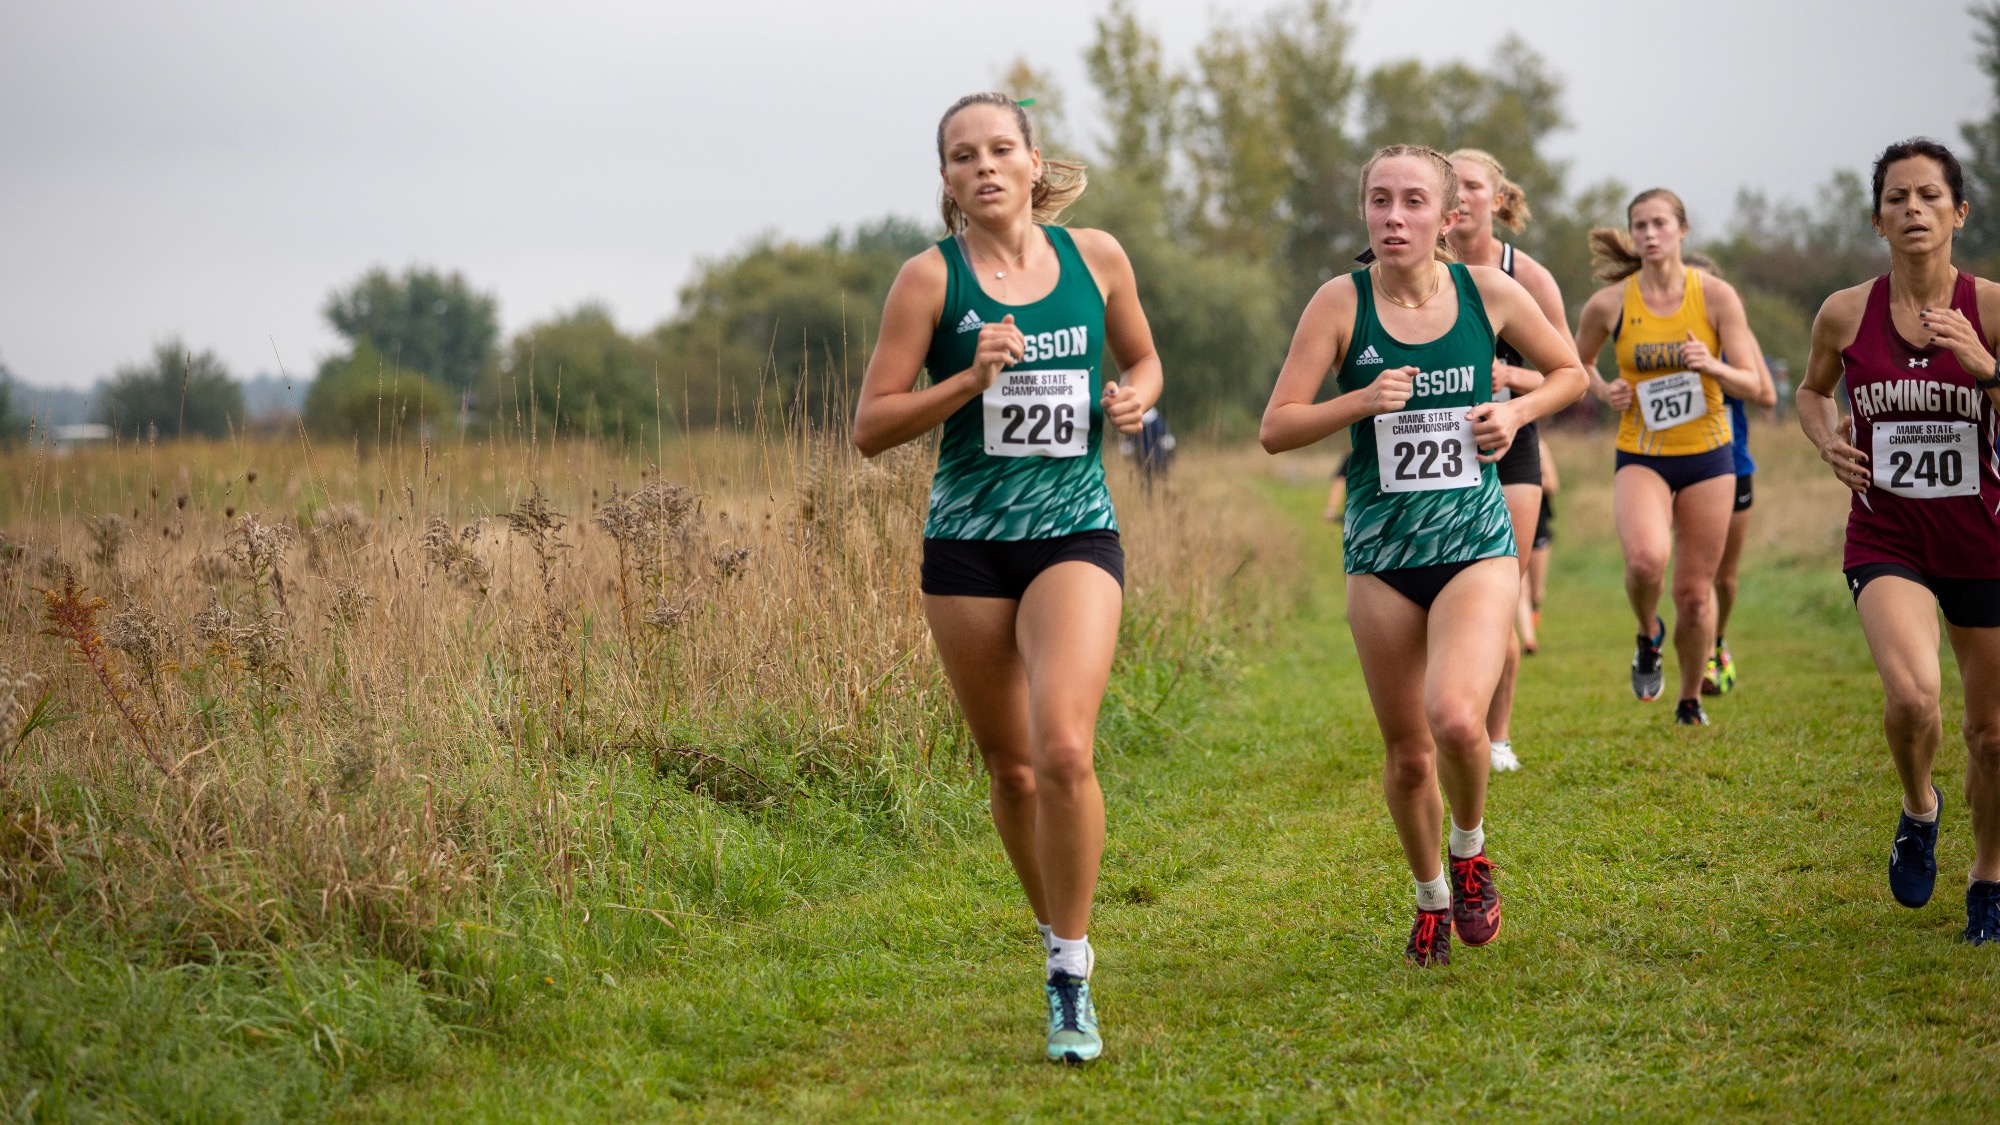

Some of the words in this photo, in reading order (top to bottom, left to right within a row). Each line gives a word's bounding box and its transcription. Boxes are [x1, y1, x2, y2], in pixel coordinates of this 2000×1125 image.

[1013, 325, 1087, 364] SSON
[1356, 357, 1384, 366] adidas
[1002, 385, 1073, 396] CHAMPIONSHIPS
[1009, 375, 1038, 385] MAINE
[1041, 374, 1067, 385] STATE
[1409, 366, 1475, 398] SSON
[1651, 391, 1692, 422] 257
[1854, 379, 1983, 421] FARMINGTON
[1002, 404, 1074, 445] 226
[1392, 421, 1460, 435] CHAMPIONSHIPS
[1398, 413, 1426, 424] MAINE
[1428, 412, 1453, 423] STATE
[1889, 434, 1961, 445] CHAMPIONSHIPS
[1896, 425, 1924, 435] MAINE
[1926, 424, 1954, 434] STATE
[1394, 438, 1463, 481] 223
[1889, 449, 1963, 488] 240
